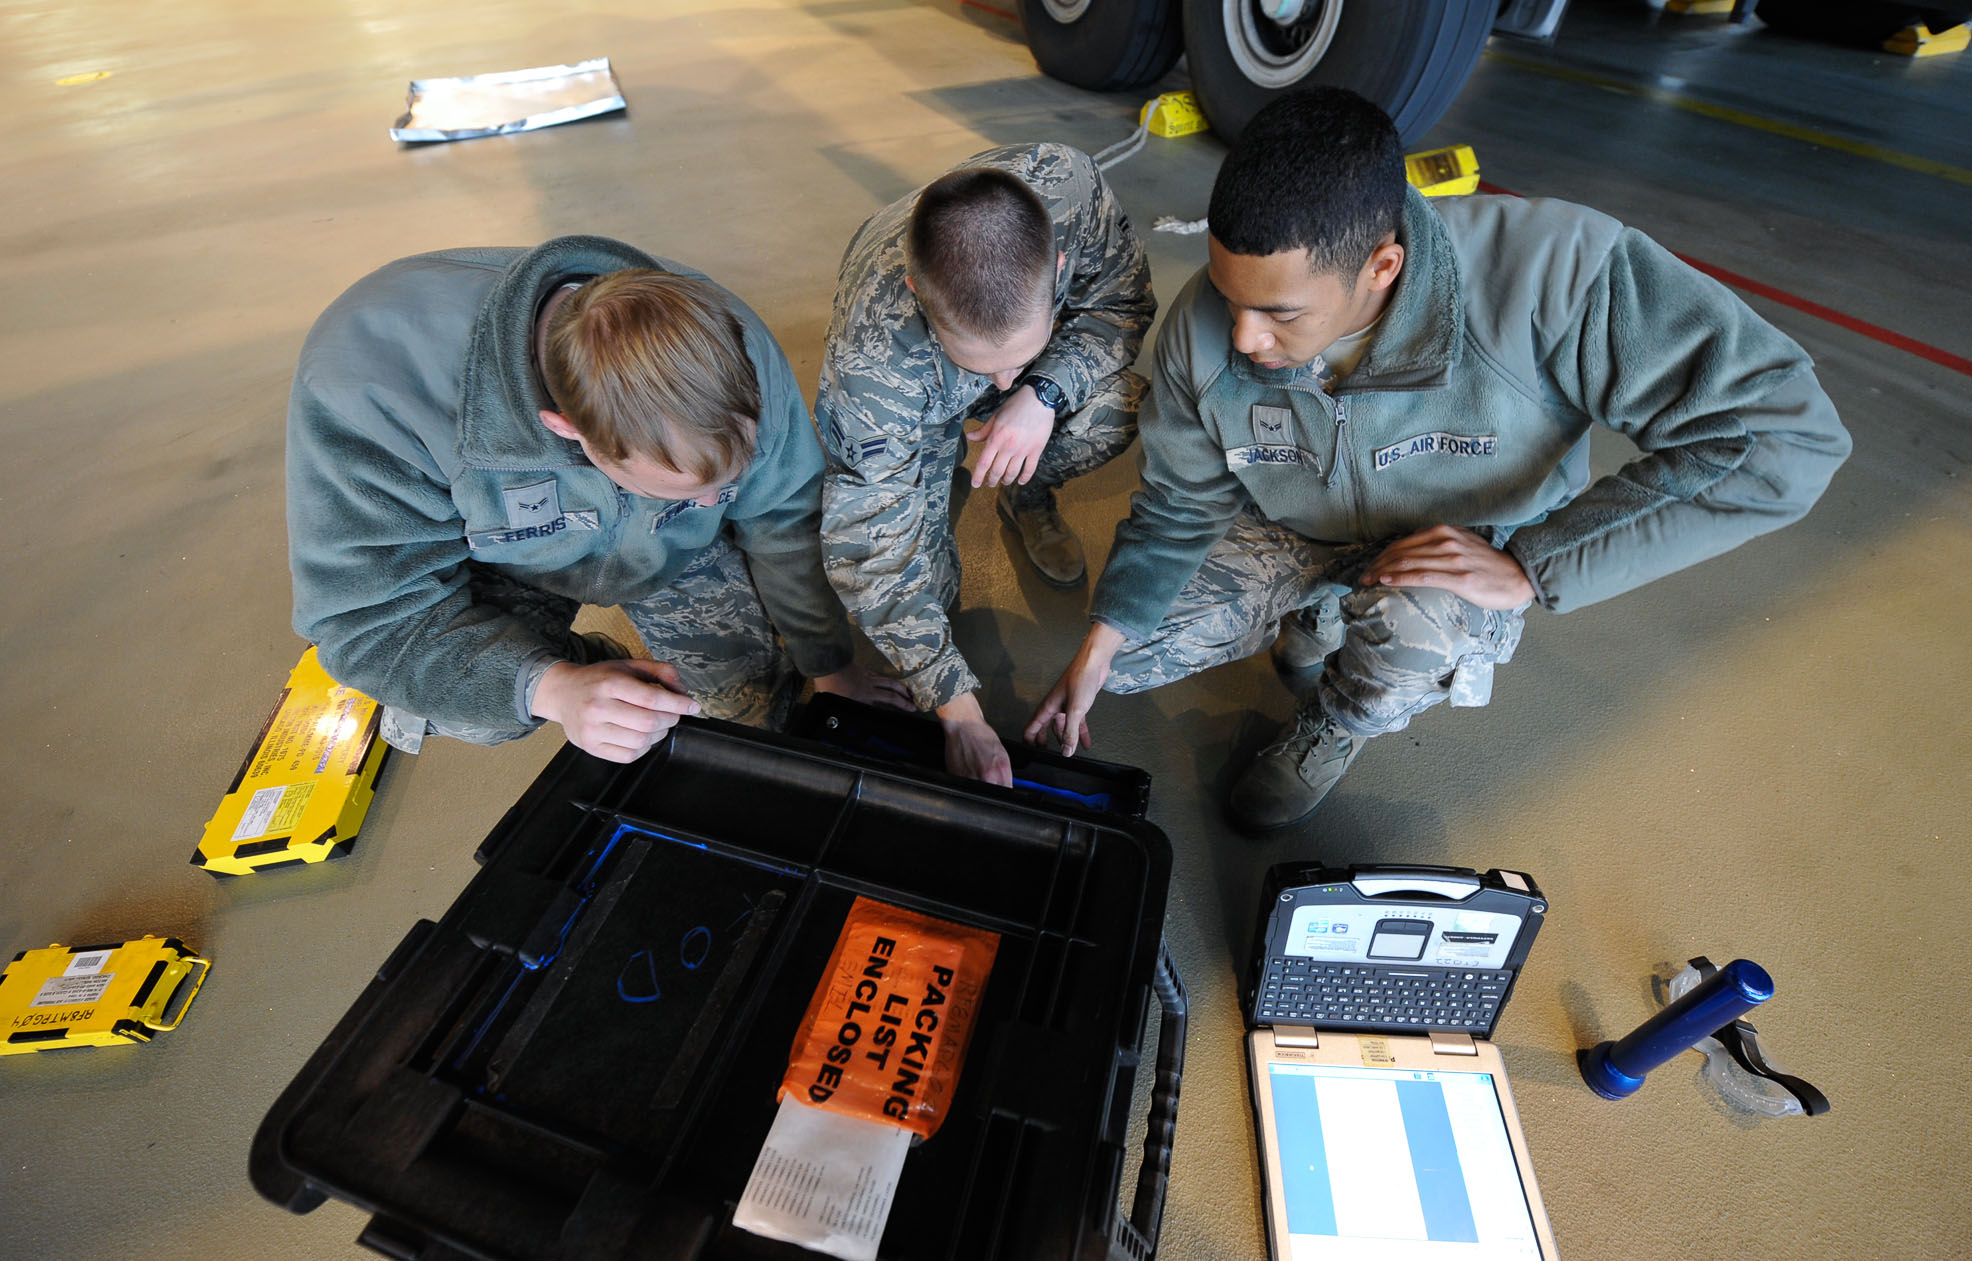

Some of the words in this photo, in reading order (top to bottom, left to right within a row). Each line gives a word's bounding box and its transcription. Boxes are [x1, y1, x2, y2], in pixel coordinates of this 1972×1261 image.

[1247, 447, 1304, 465] JACKSON
[1379, 447, 1405, 467] U.S.
[1410, 437, 1434, 455] AIR
[1440, 437, 1492, 456] FORCE
[504, 515, 566, 542] FERRIS
[808, 936, 896, 1104] ENCLOSED
[865, 993, 909, 1071] LIST
[883, 965, 955, 1121] PACKING
